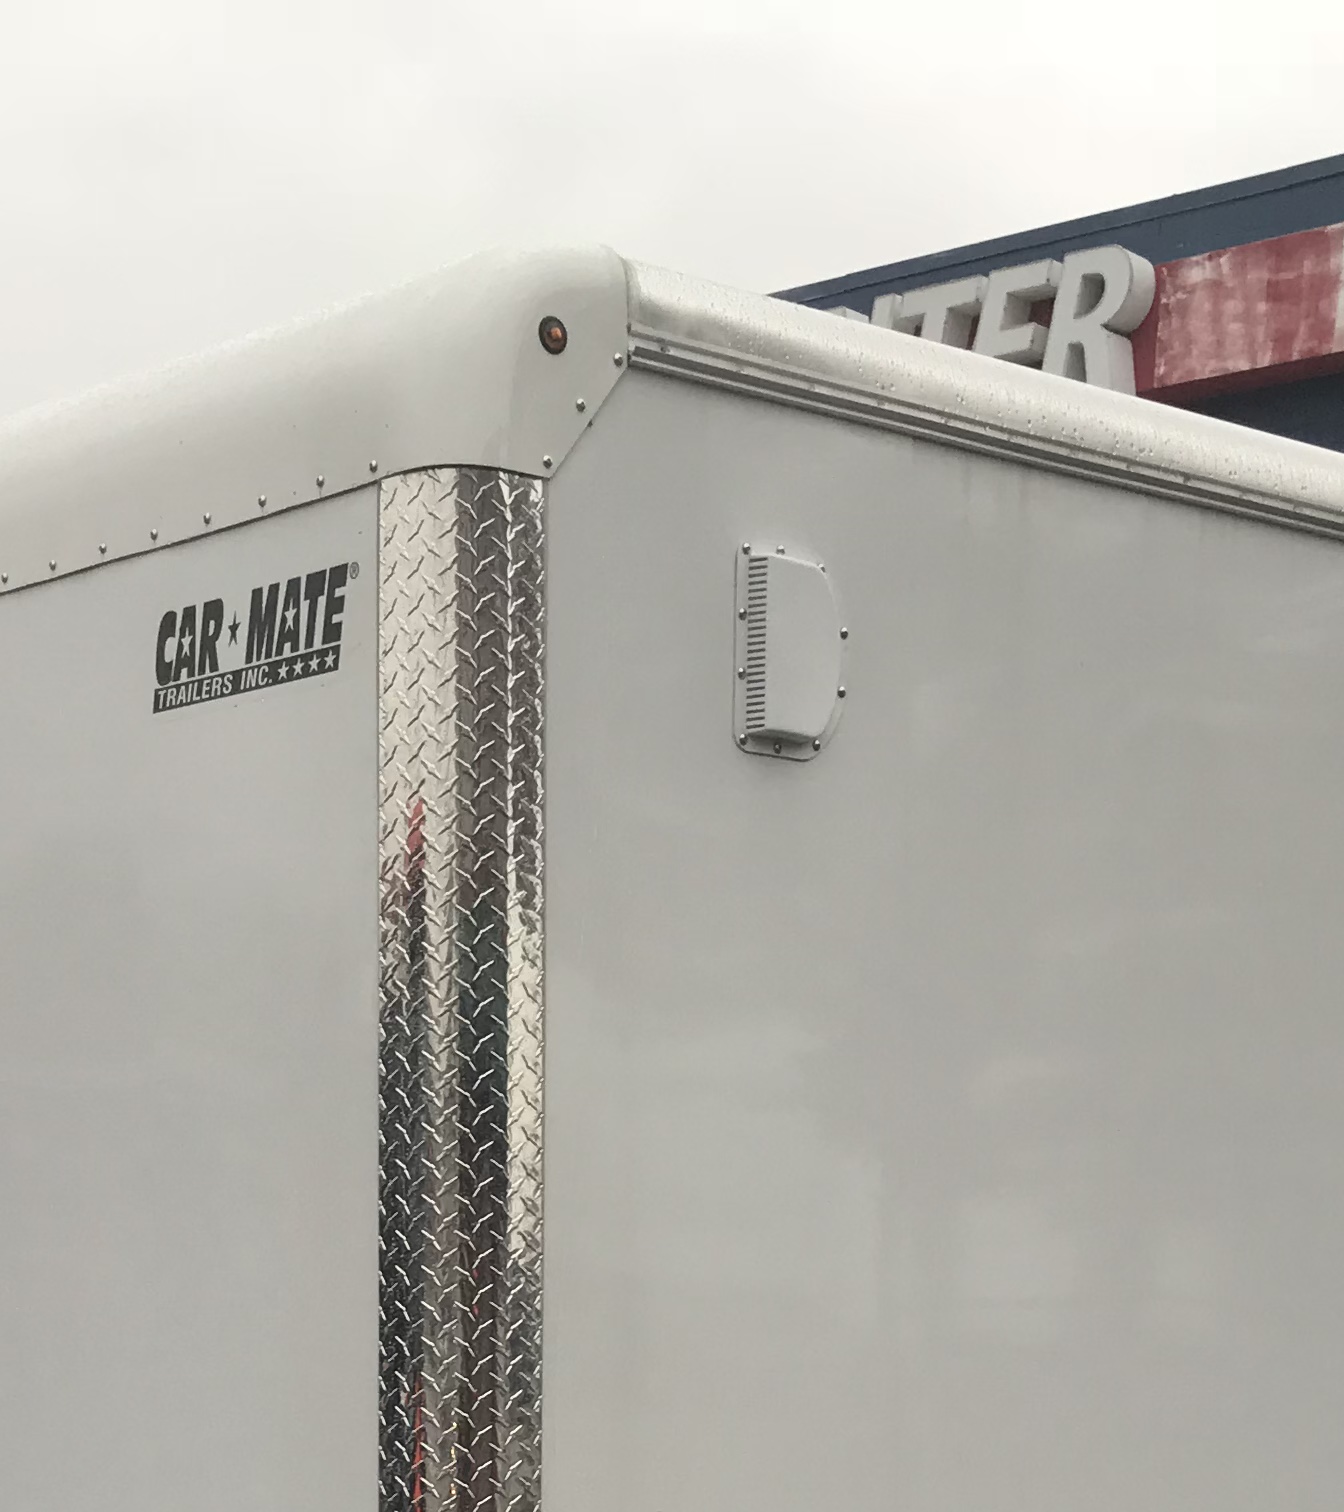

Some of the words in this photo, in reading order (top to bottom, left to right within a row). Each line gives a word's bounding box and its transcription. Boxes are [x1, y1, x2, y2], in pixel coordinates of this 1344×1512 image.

[155, 597, 224, 687] CAR
[244, 562, 350, 665] MATE
[157, 674, 234, 710] TRAILERS
[240, 664, 273, 690] INC.
